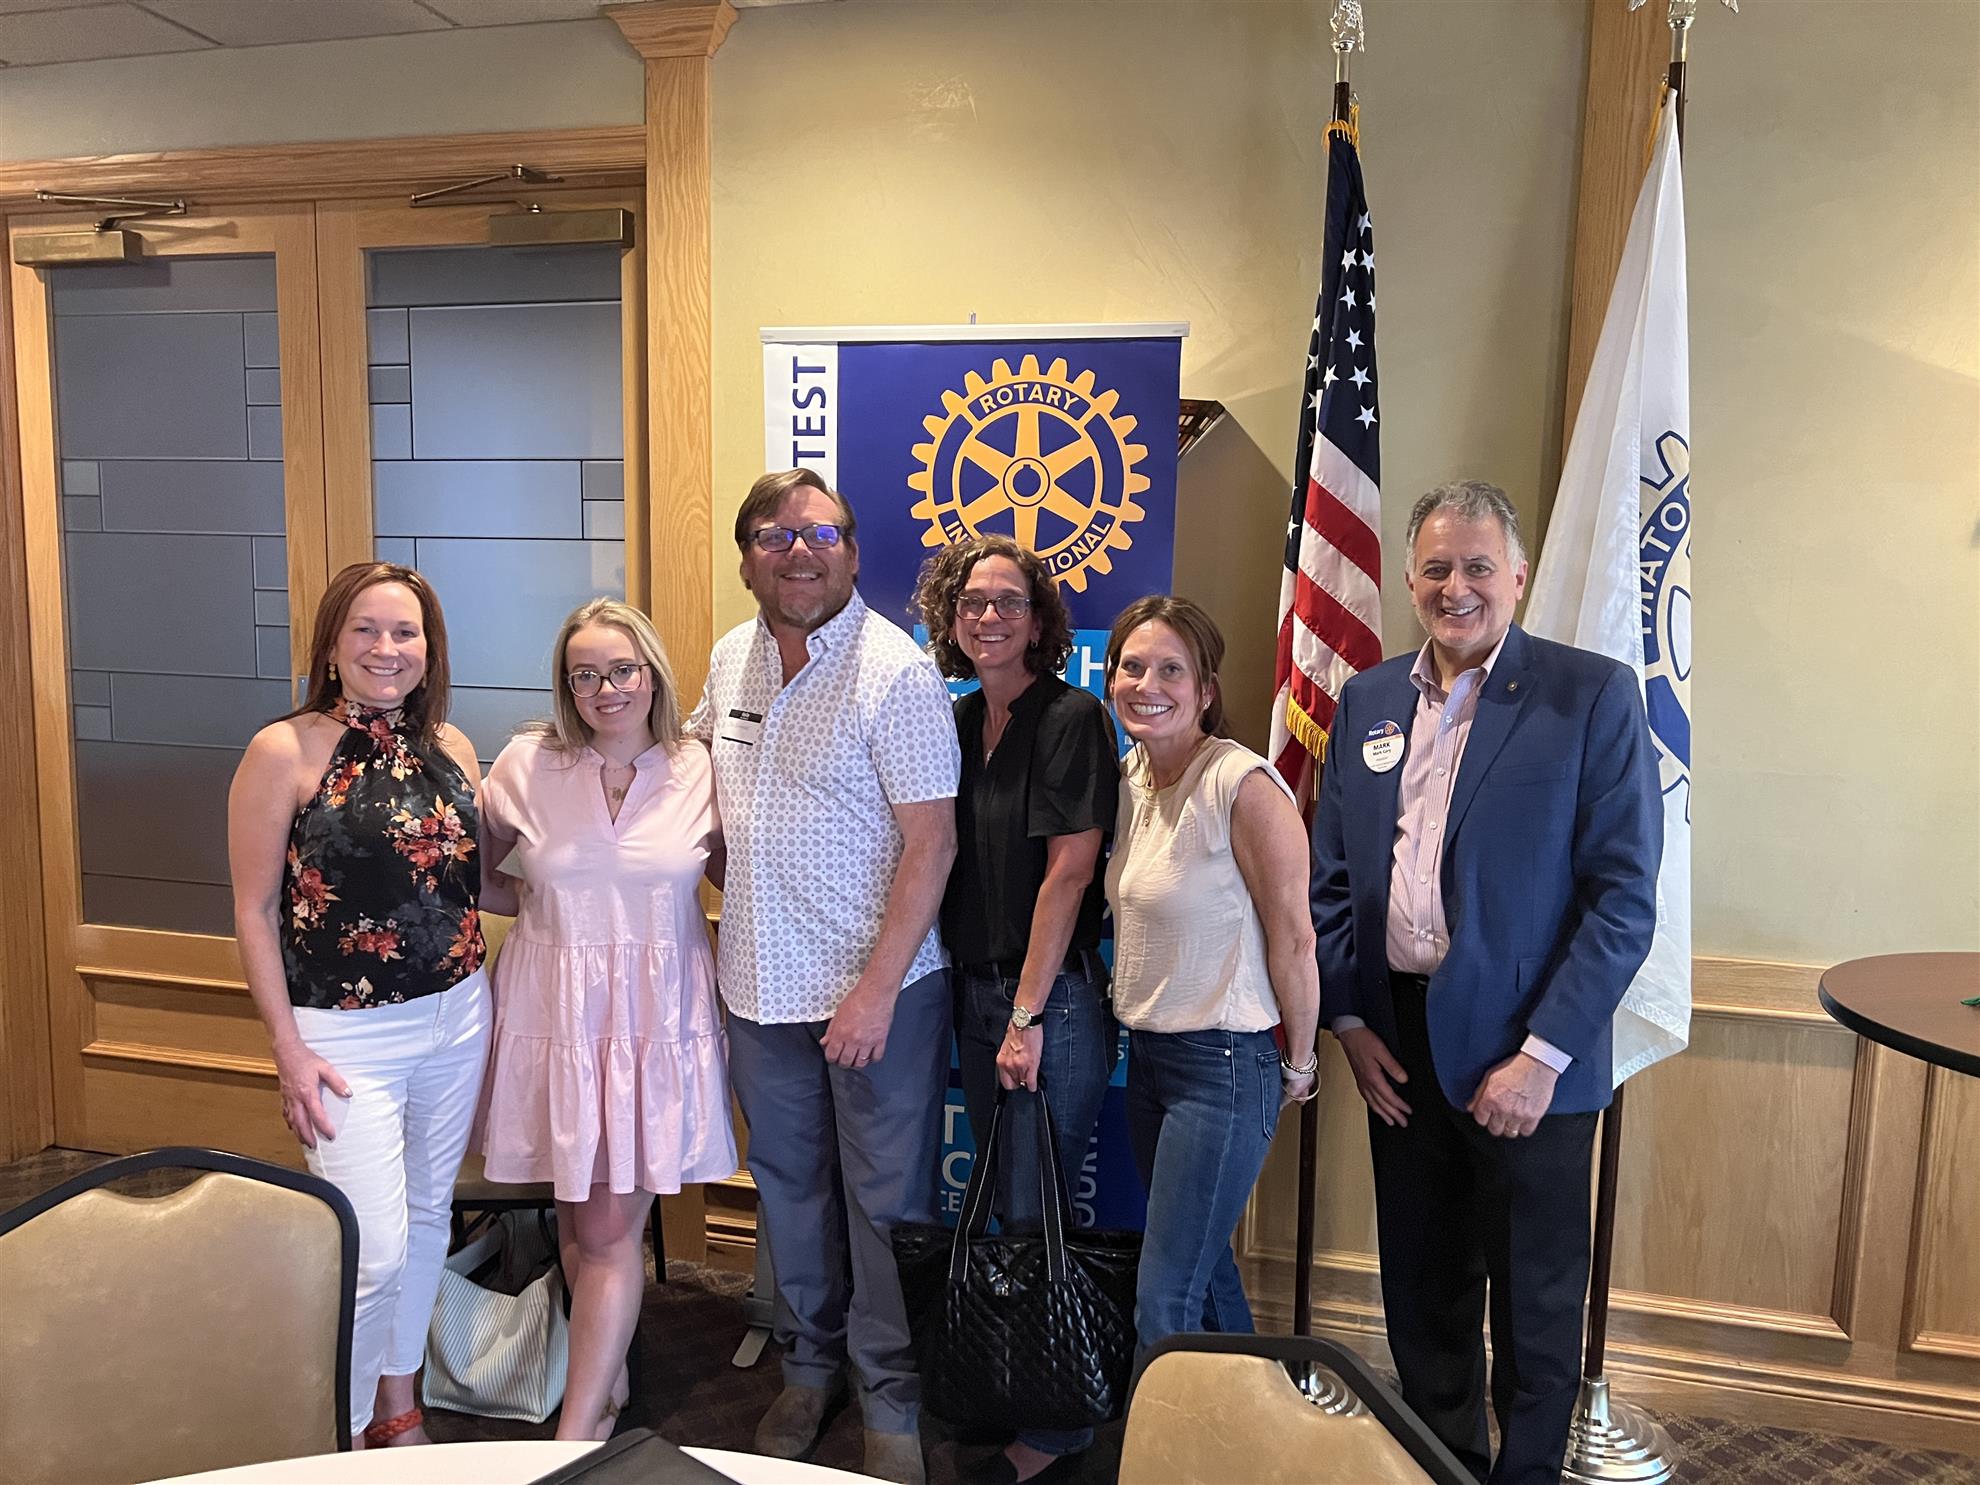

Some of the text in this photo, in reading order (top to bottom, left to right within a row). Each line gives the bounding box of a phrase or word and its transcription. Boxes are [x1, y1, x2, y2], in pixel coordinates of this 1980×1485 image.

[792, 356, 827, 467] TEST
[978, 383, 1079, 414] ROTARY
[944, 519, 1111, 575] INIONAL
